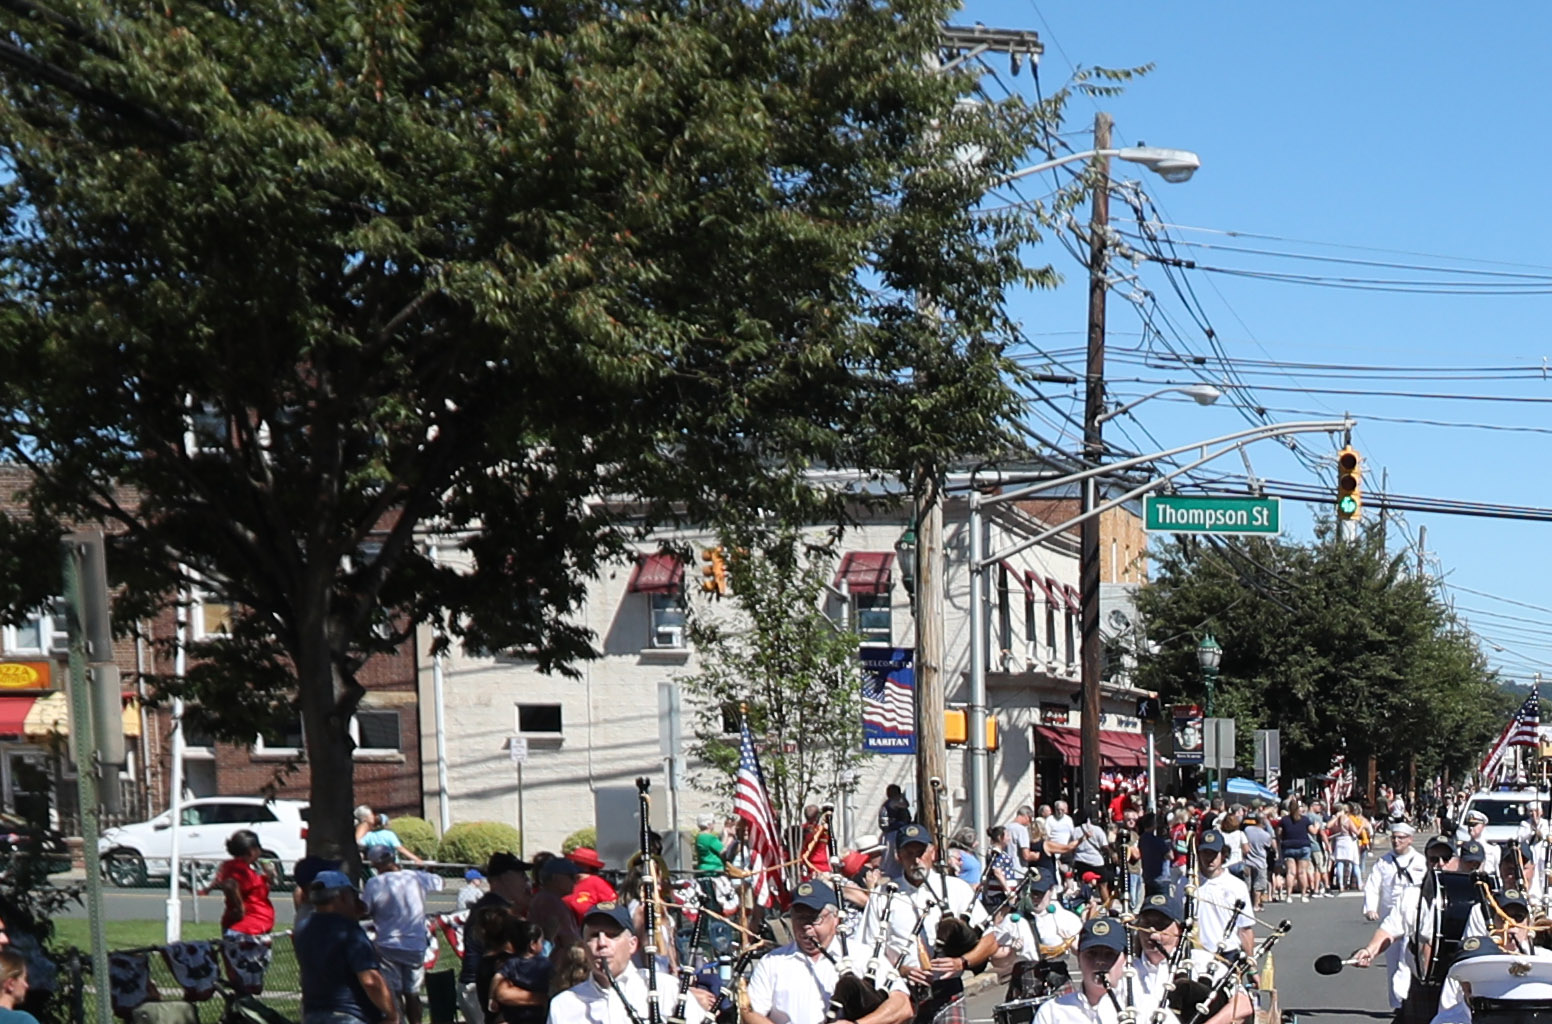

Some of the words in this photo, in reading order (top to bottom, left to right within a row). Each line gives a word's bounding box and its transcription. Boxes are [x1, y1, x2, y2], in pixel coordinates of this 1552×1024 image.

[1156, 504, 1247, 529] Thompson
[1252, 506, 1269, 526] St
[868, 738, 909, 746] RARITAN
